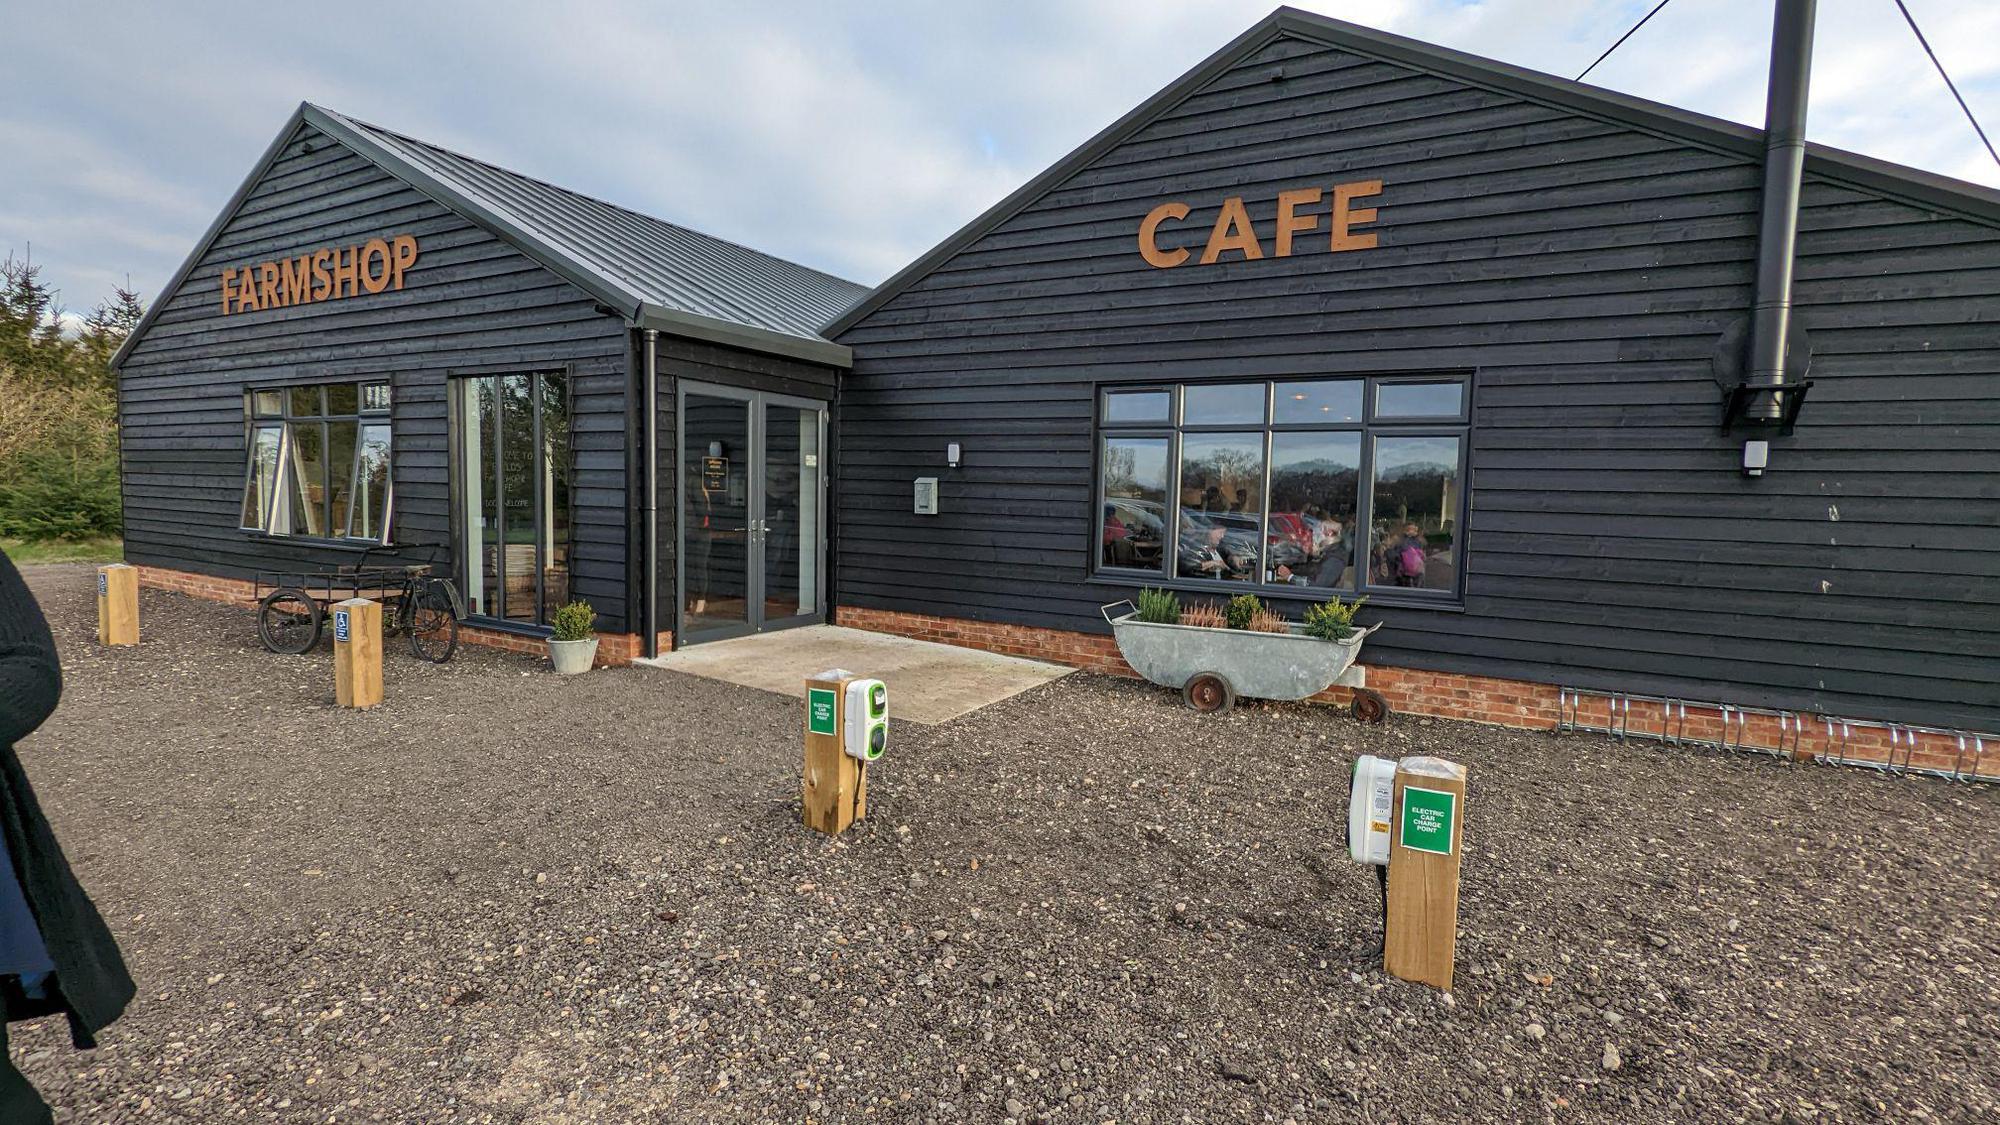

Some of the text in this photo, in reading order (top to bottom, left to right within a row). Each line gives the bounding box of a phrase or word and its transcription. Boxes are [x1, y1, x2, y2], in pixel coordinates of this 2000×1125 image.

[1138, 179, 1383, 269] CAFE
[222, 233, 418, 316] FARMSHOP
[1412, 807, 1445, 817] ELECTRIC
[1413, 819, 1442, 829] CHARGE
[1416, 825, 1437, 833] POINT
